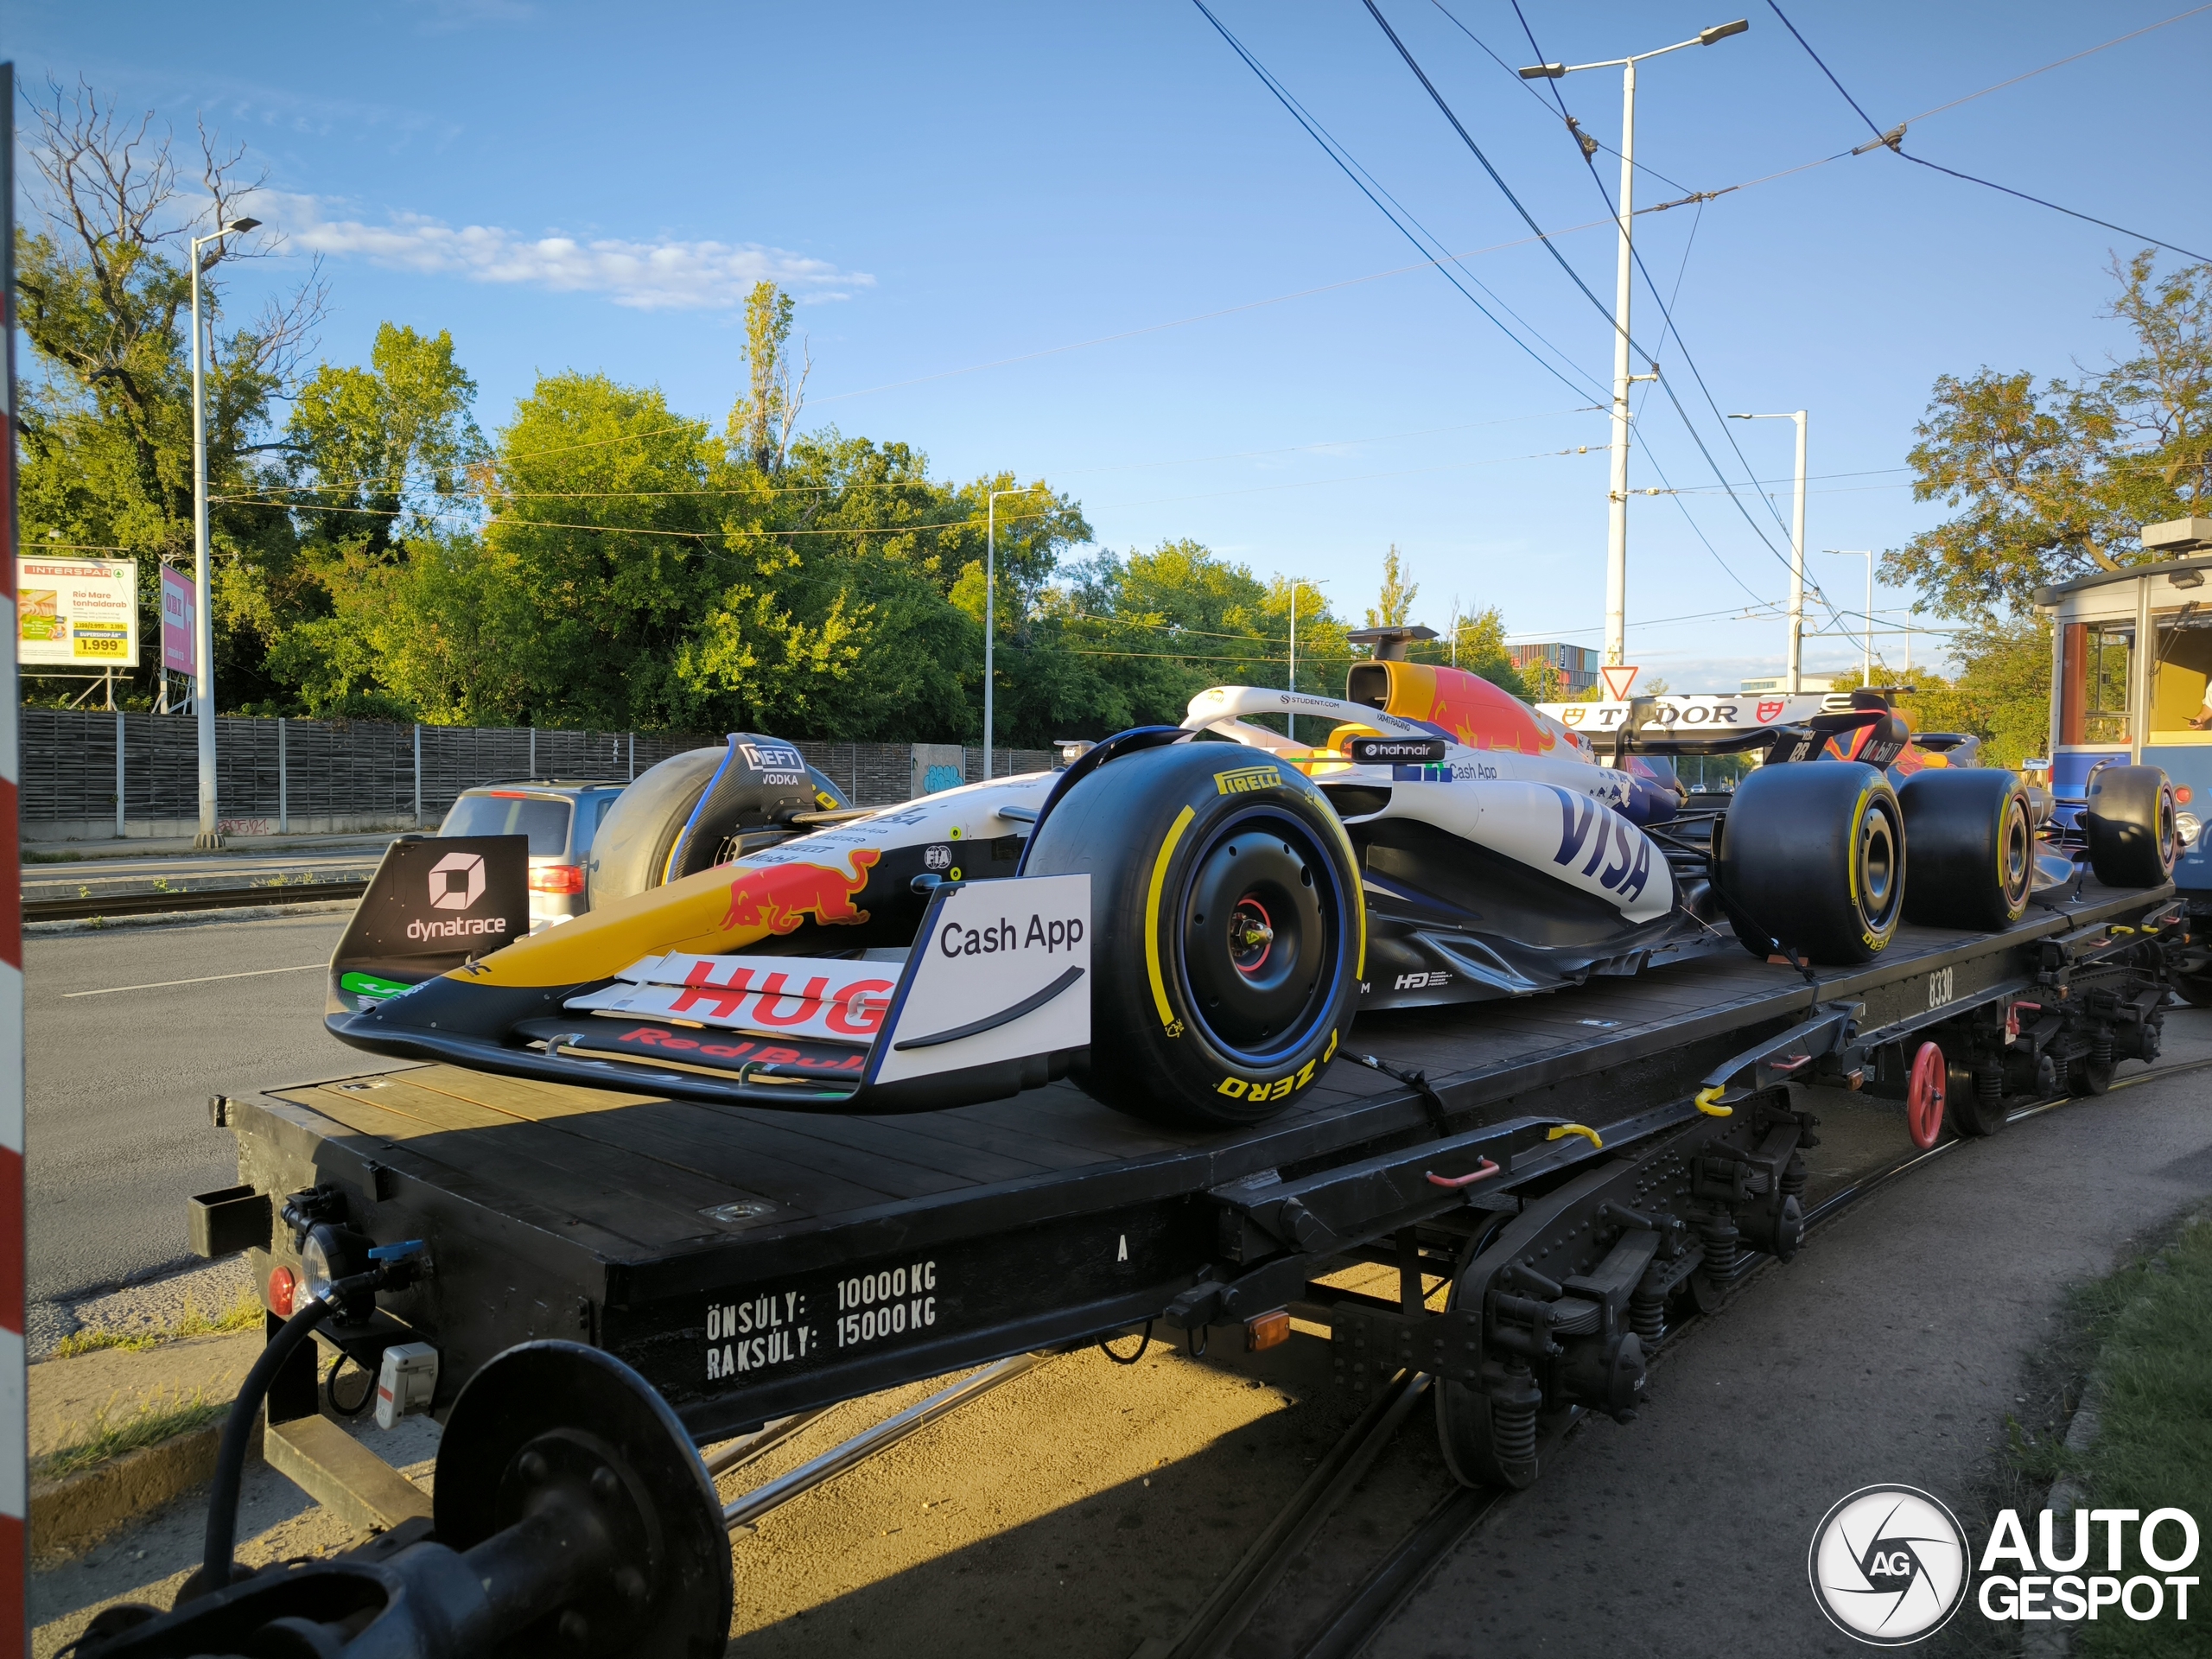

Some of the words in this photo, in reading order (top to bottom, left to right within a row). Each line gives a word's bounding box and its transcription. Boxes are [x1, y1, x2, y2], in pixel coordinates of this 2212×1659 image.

[32, 566, 111, 577] INTERSPAR
[73, 600, 127, 608] tonhaldarab
[166, 592, 182, 618] OBI
[81, 639, 118, 651] 1.999
[1291, 696, 1339, 709] STUDENT.COM
[1599, 705, 1738, 726] TDOR
[748, 748, 796, 766] NEFT
[1379, 743, 1431, 756] hahnair
[1859, 739, 1891, 762] Mobil
[763, 774, 799, 785] VODKA
[1213, 766, 1282, 796] PIRELLI
[1449, 764, 1476, 779] Cash
[1478, 763, 1497, 779] App
[1545, 783, 1650, 903] VISA
[406, 916, 506, 942] dynatrace
[940, 917, 1017, 958] Cash
[1024, 913, 1084, 954] App
[1929, 966, 1953, 1008] 8330
[618, 1027, 755, 1058] Red
[747, 1045, 864, 1071] Bul
[1217, 1058, 1316, 1102] ZERO
[1117, 1234, 1128, 1262] A
[706, 1291, 806, 1342] ÖNSÚLY:
[837, 1267, 906, 1312] 10000
[912, 1261, 937, 1294] KG
[706, 1326, 818, 1381] RAKSÚLY:
[836, 1306, 906, 1348] 15000
[911, 1296, 937, 1330] KG
